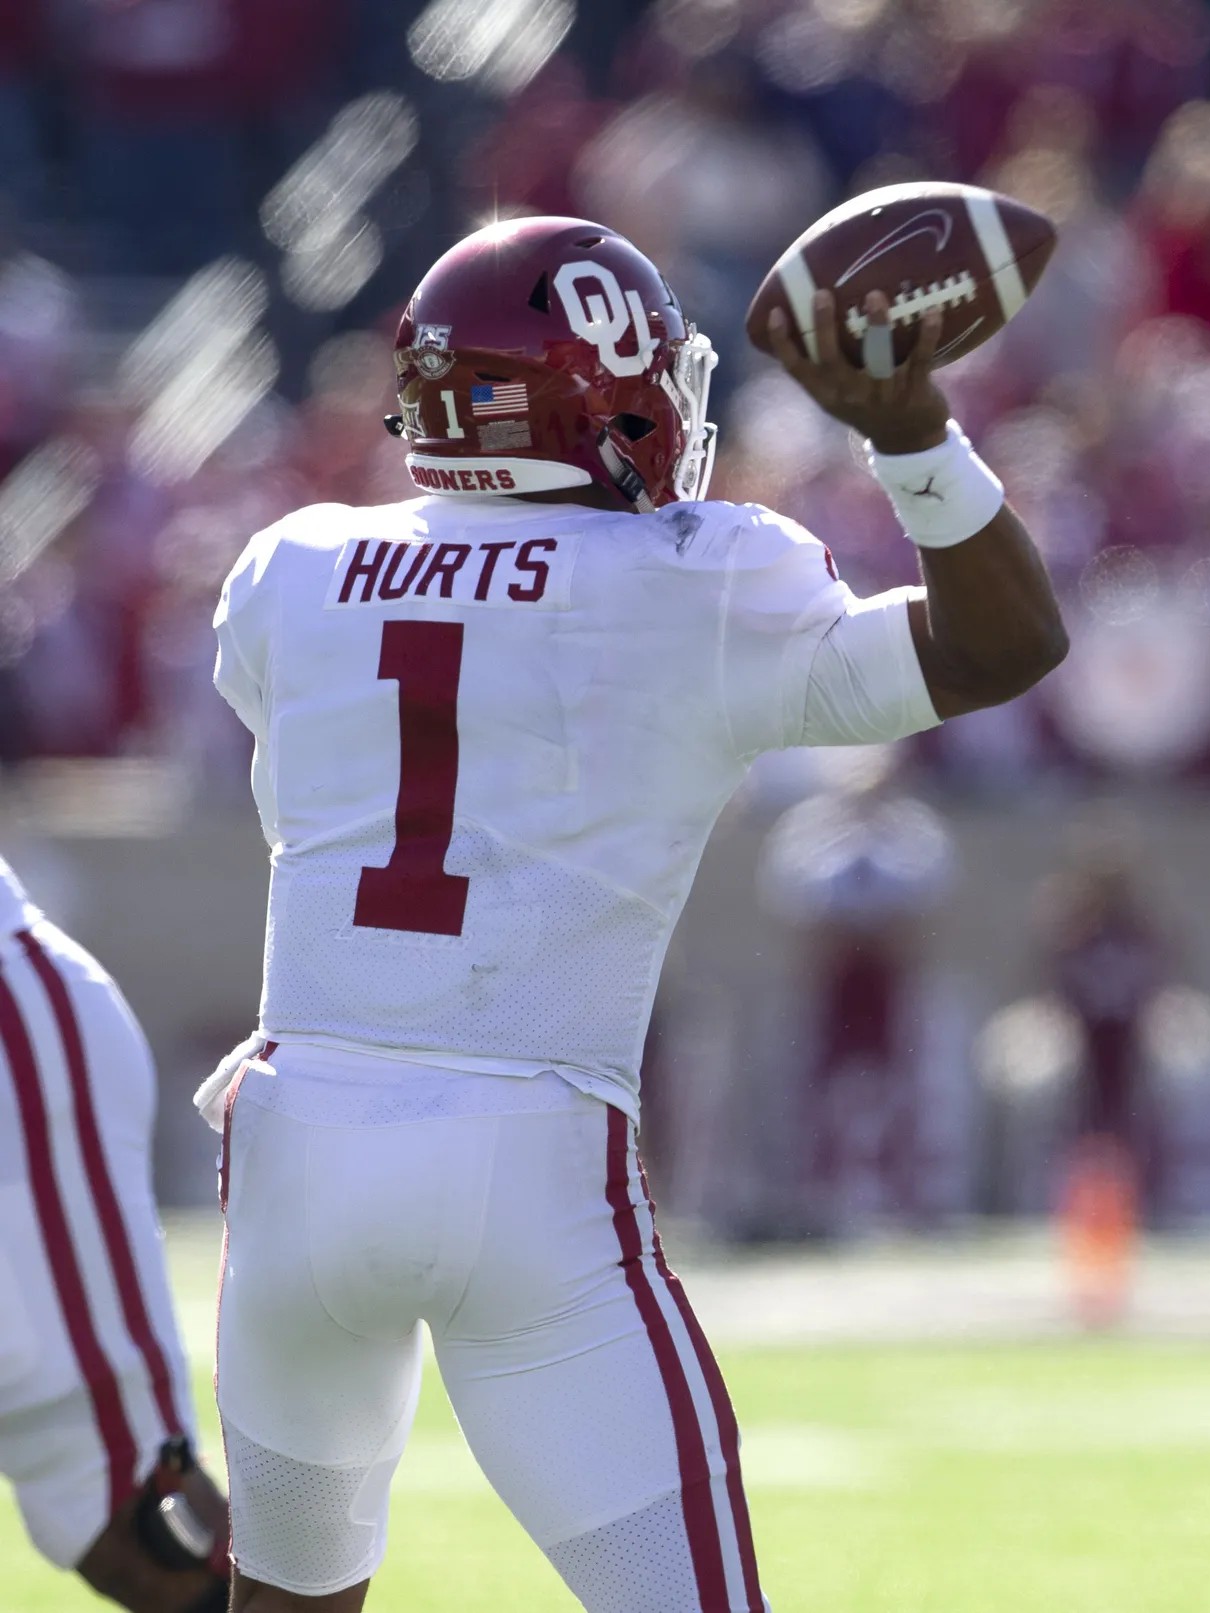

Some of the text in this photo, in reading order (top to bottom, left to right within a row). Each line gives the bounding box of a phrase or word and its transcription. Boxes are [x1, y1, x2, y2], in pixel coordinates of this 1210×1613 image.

[412, 324, 452, 352] 125
[553, 260, 660, 378] OU
[440, 390, 465, 439] 1
[410, 465, 516, 491] SOONERS
[338, 538, 558, 603] HURTS
[353, 620, 470, 937] 1
